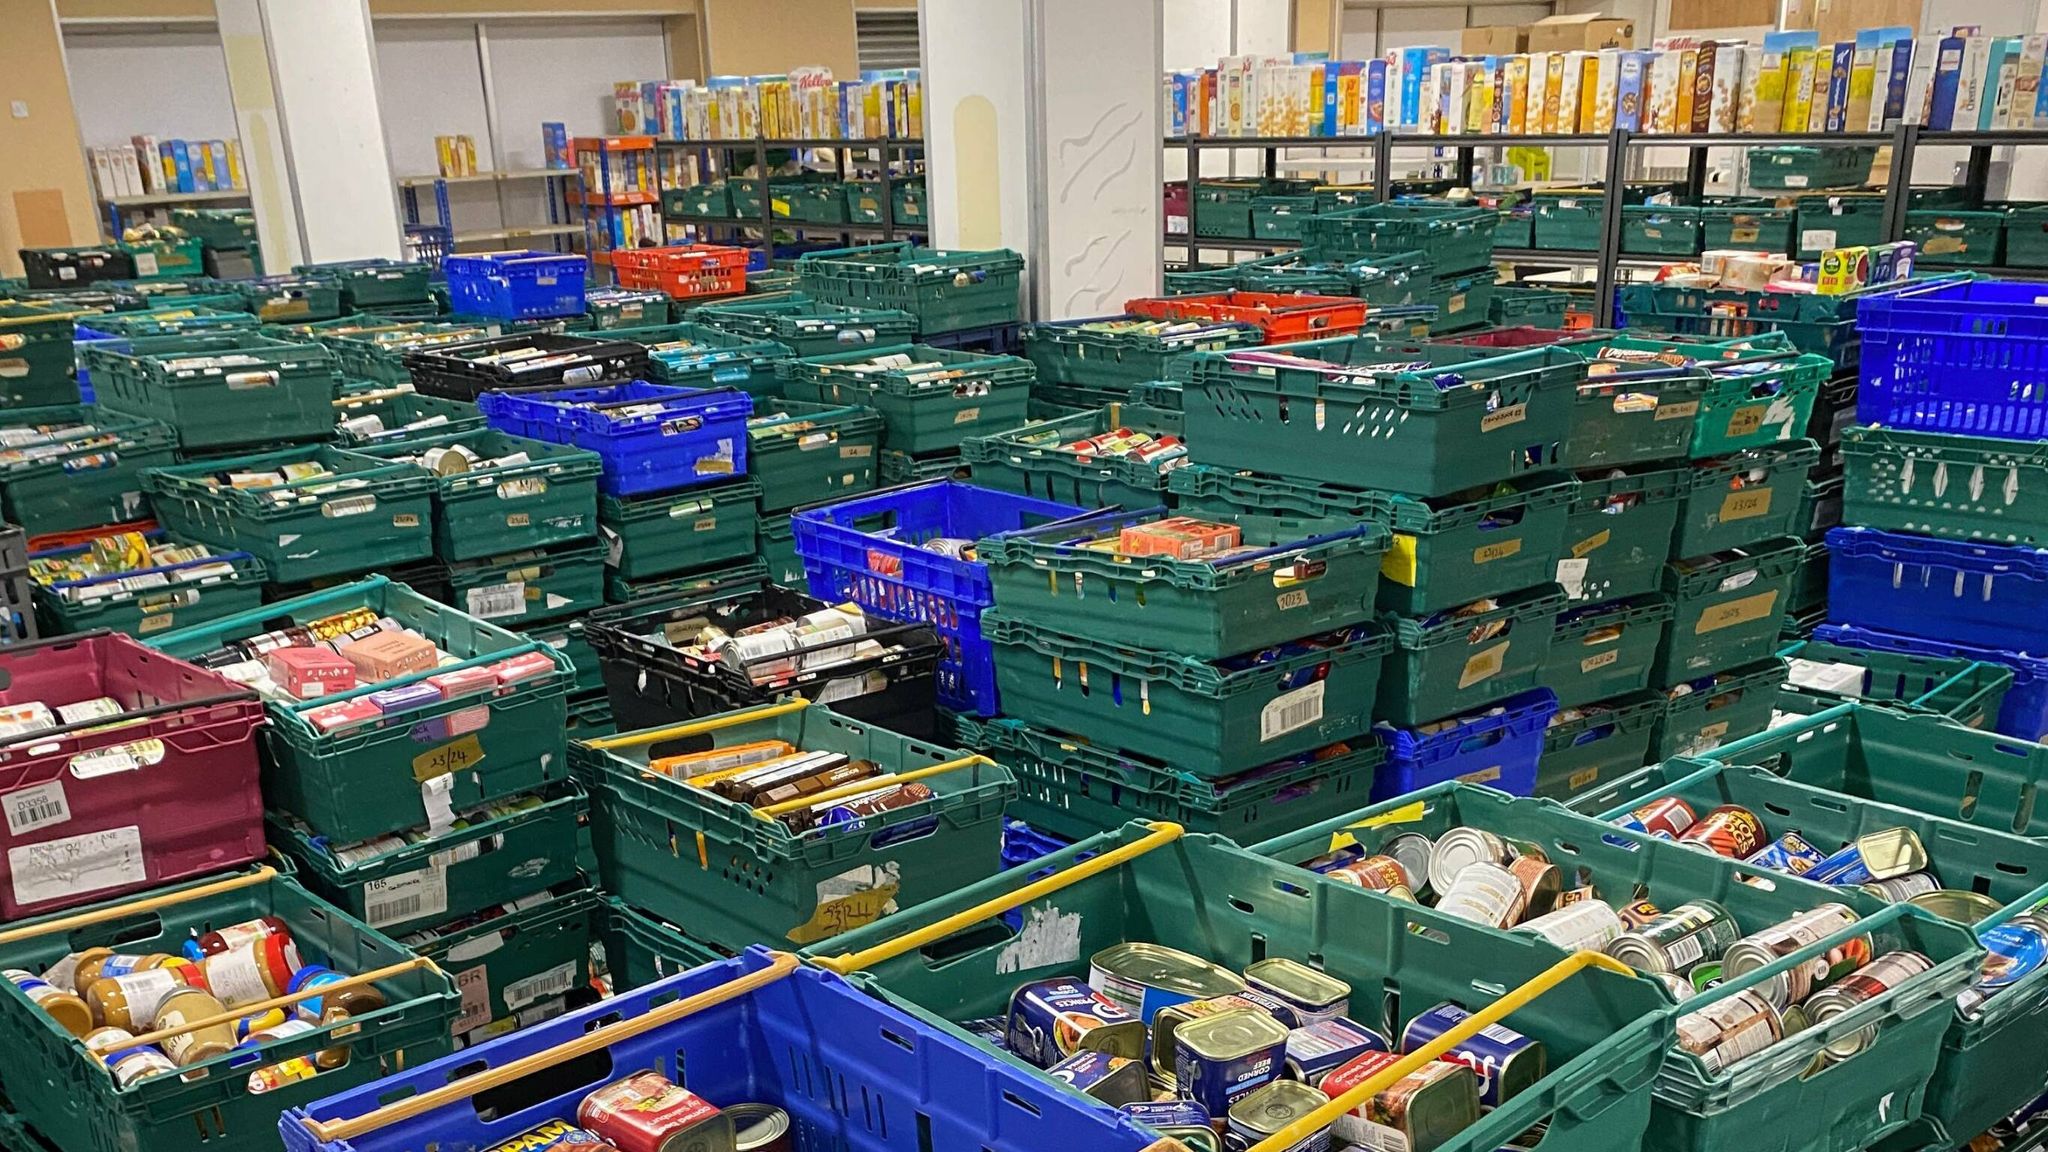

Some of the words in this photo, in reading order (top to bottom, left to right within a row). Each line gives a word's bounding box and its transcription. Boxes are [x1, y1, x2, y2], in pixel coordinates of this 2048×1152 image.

[431, 747, 469, 772] 23/24
[17, 795, 49, 811] D3358
[1731, 813, 1756, 848] HOT
[367, 879, 387, 891] 165
[1252, 1057, 1273, 1070] BEEF
[1238, 1065, 1271, 1082] CORNED
